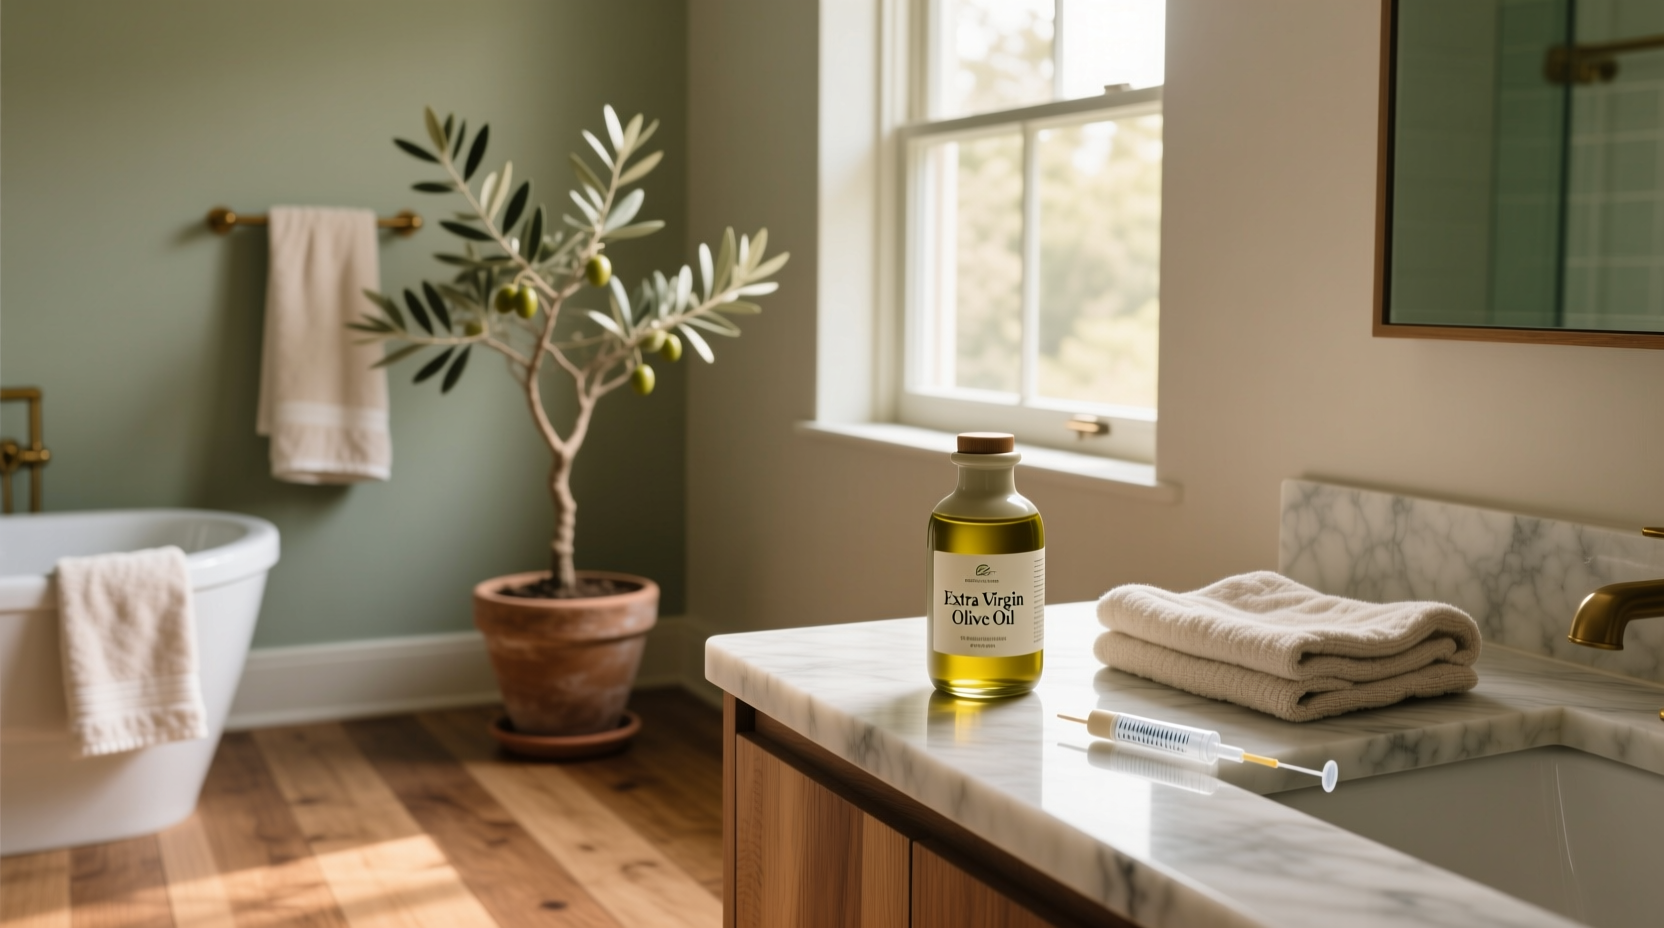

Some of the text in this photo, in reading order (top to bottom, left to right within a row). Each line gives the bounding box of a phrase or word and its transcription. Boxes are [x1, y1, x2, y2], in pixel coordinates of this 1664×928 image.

[944, 590, 1024, 611] Extra Virgin
[952, 609, 1014, 625] Olive Oil
